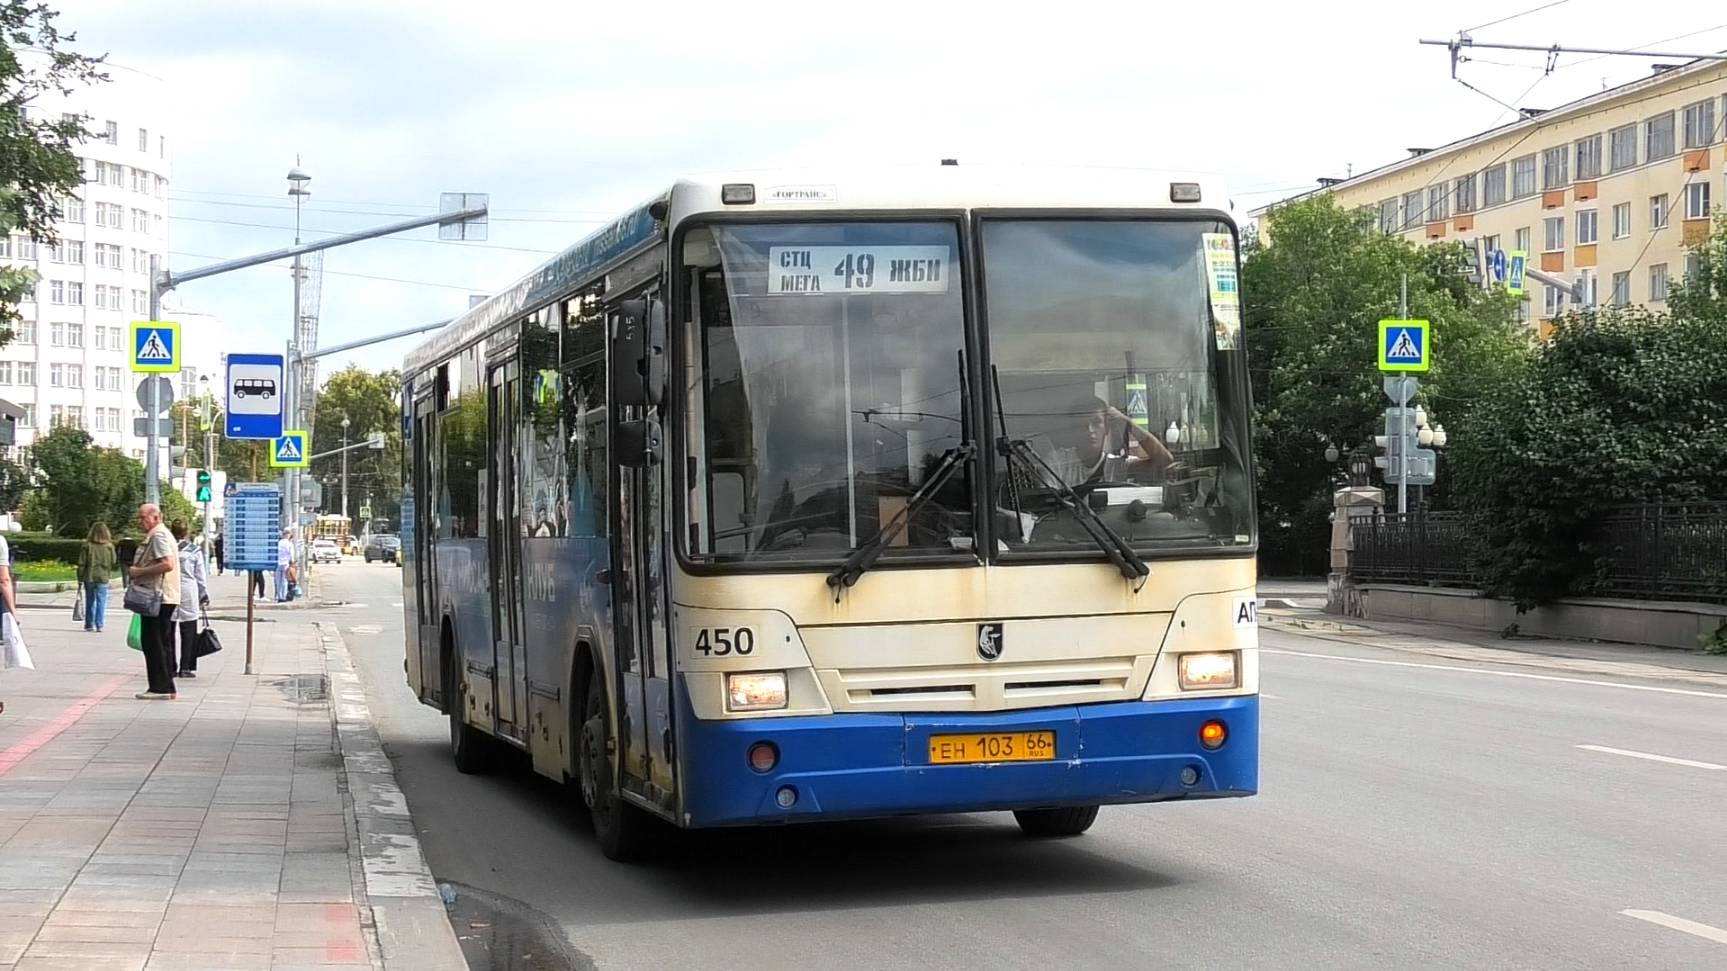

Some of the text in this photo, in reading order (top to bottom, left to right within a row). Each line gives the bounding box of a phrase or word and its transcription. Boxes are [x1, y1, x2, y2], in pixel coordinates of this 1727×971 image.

[780, 251, 811, 269] СТЦ
[834, 253, 875, 288] 49
[889, 259, 941, 282] ЖБИ
[781, 275, 820, 291] МЕГА
[695, 627, 754, 656] 450
[941, 734, 1046, 759] ЕН 103 66
